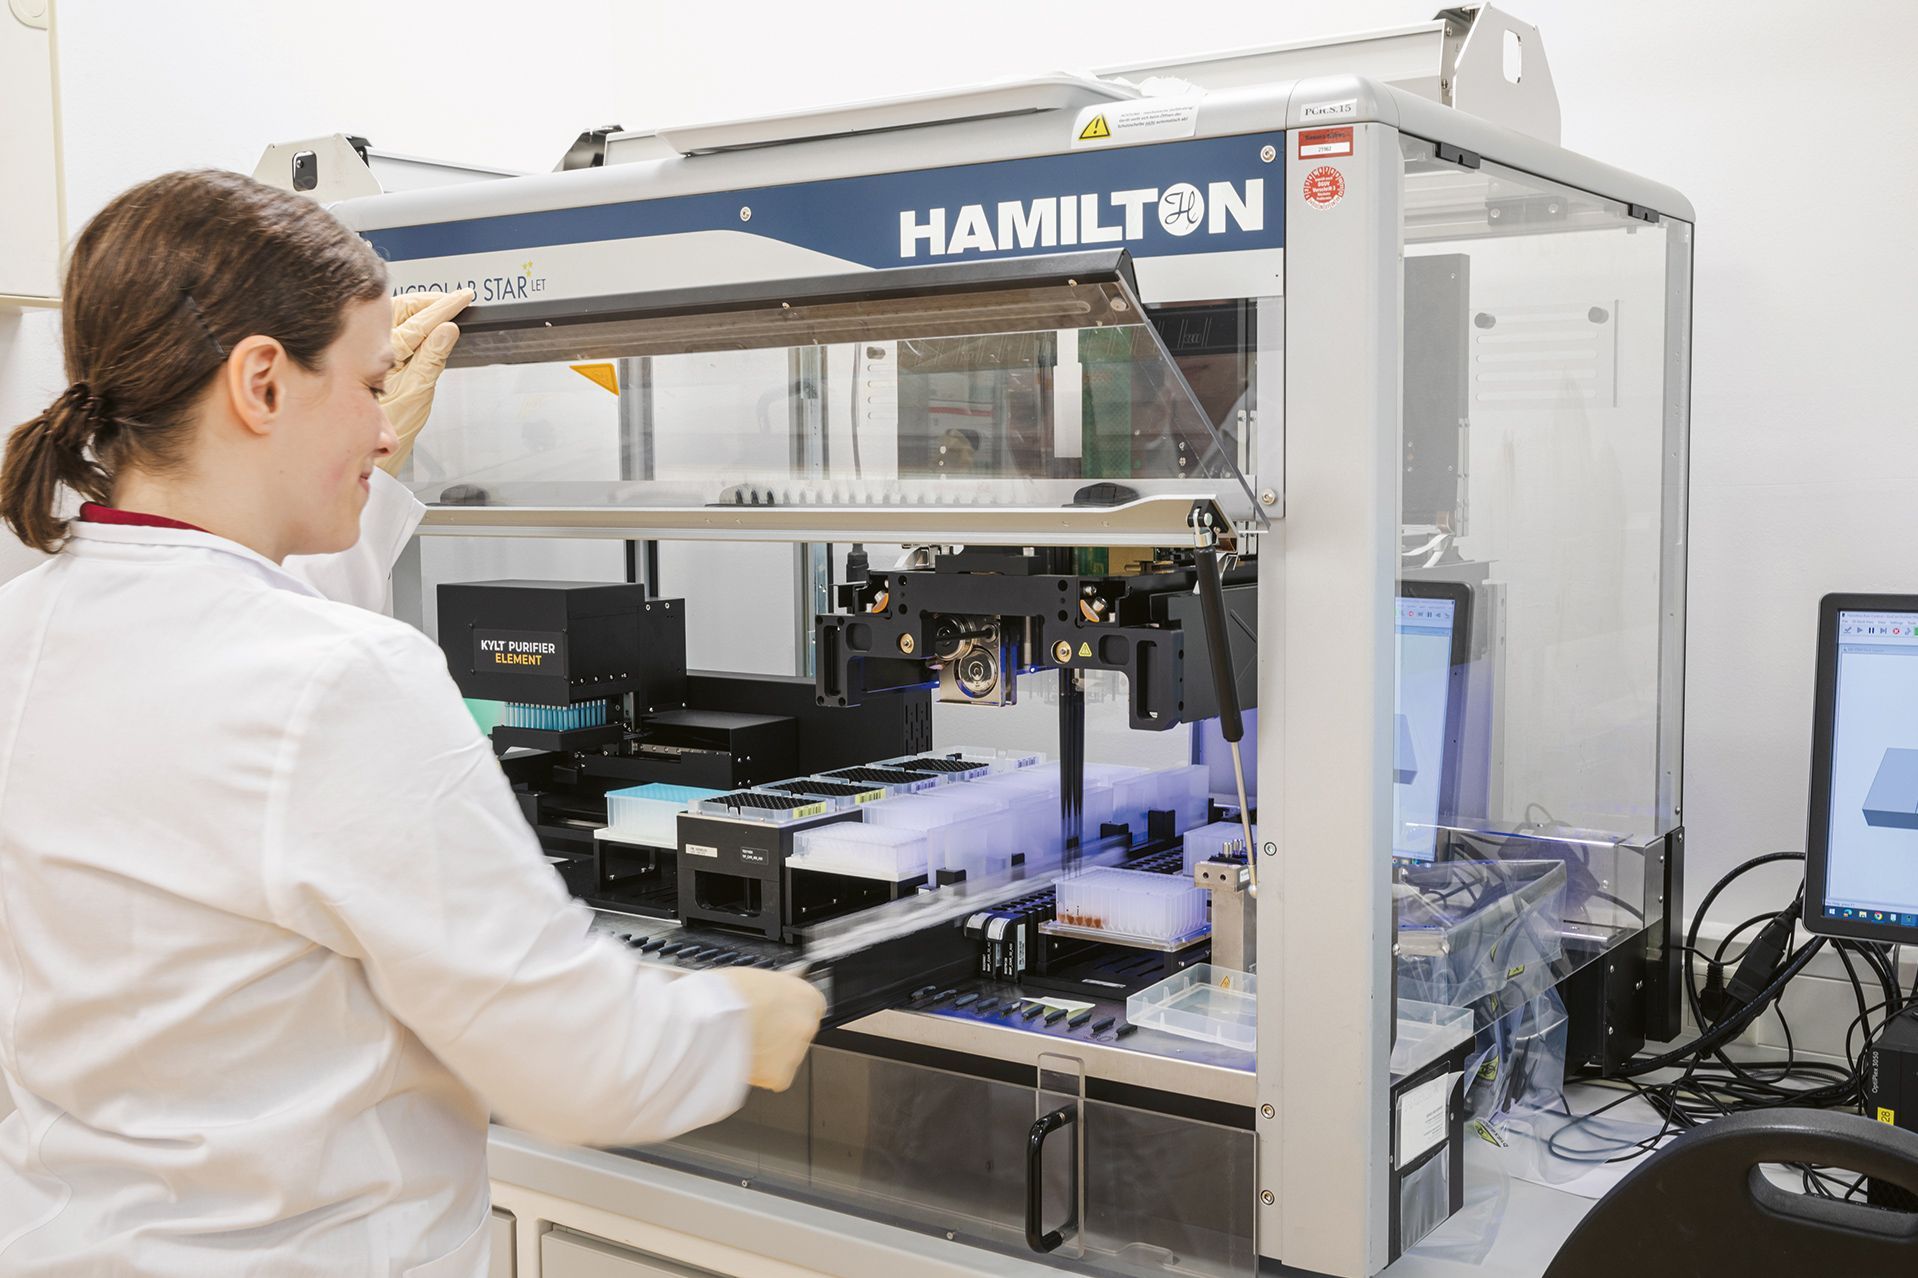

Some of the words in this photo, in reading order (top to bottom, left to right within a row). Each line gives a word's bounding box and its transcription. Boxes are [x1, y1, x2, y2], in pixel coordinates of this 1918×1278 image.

[900, 178, 1264, 258] HAMILTON
[483, 276, 528, 301] STAR
[531, 279, 546, 292] LET
[481, 640, 505, 651] KYLT
[509, 641, 556, 654] PURIFIER
[495, 653, 542, 665] ELEMENT
[1871, 1068, 1879, 1093] OptiPlex
[1881, 1111, 1890, 1122] 28
